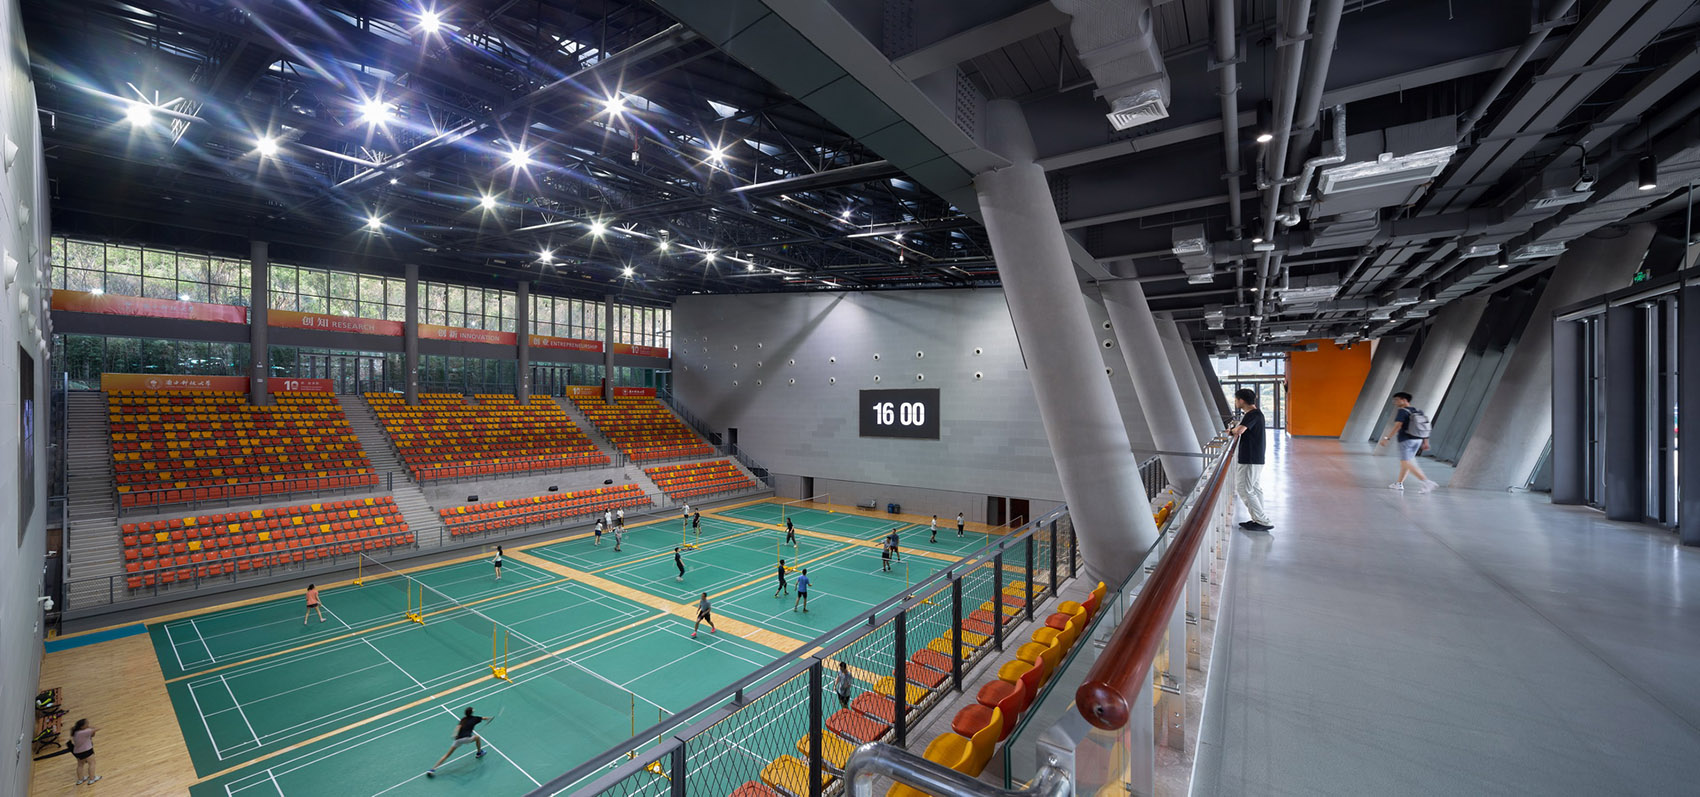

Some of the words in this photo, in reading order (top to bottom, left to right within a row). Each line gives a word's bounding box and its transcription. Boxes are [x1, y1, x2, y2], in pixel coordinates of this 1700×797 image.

[302, 316, 328, 327] 创知
[332, 321, 375, 331] RESEARCH
[459, 333, 500, 341] INNOVATION
[873, 402, 895, 425] 16
[900, 402, 925, 426] 00
